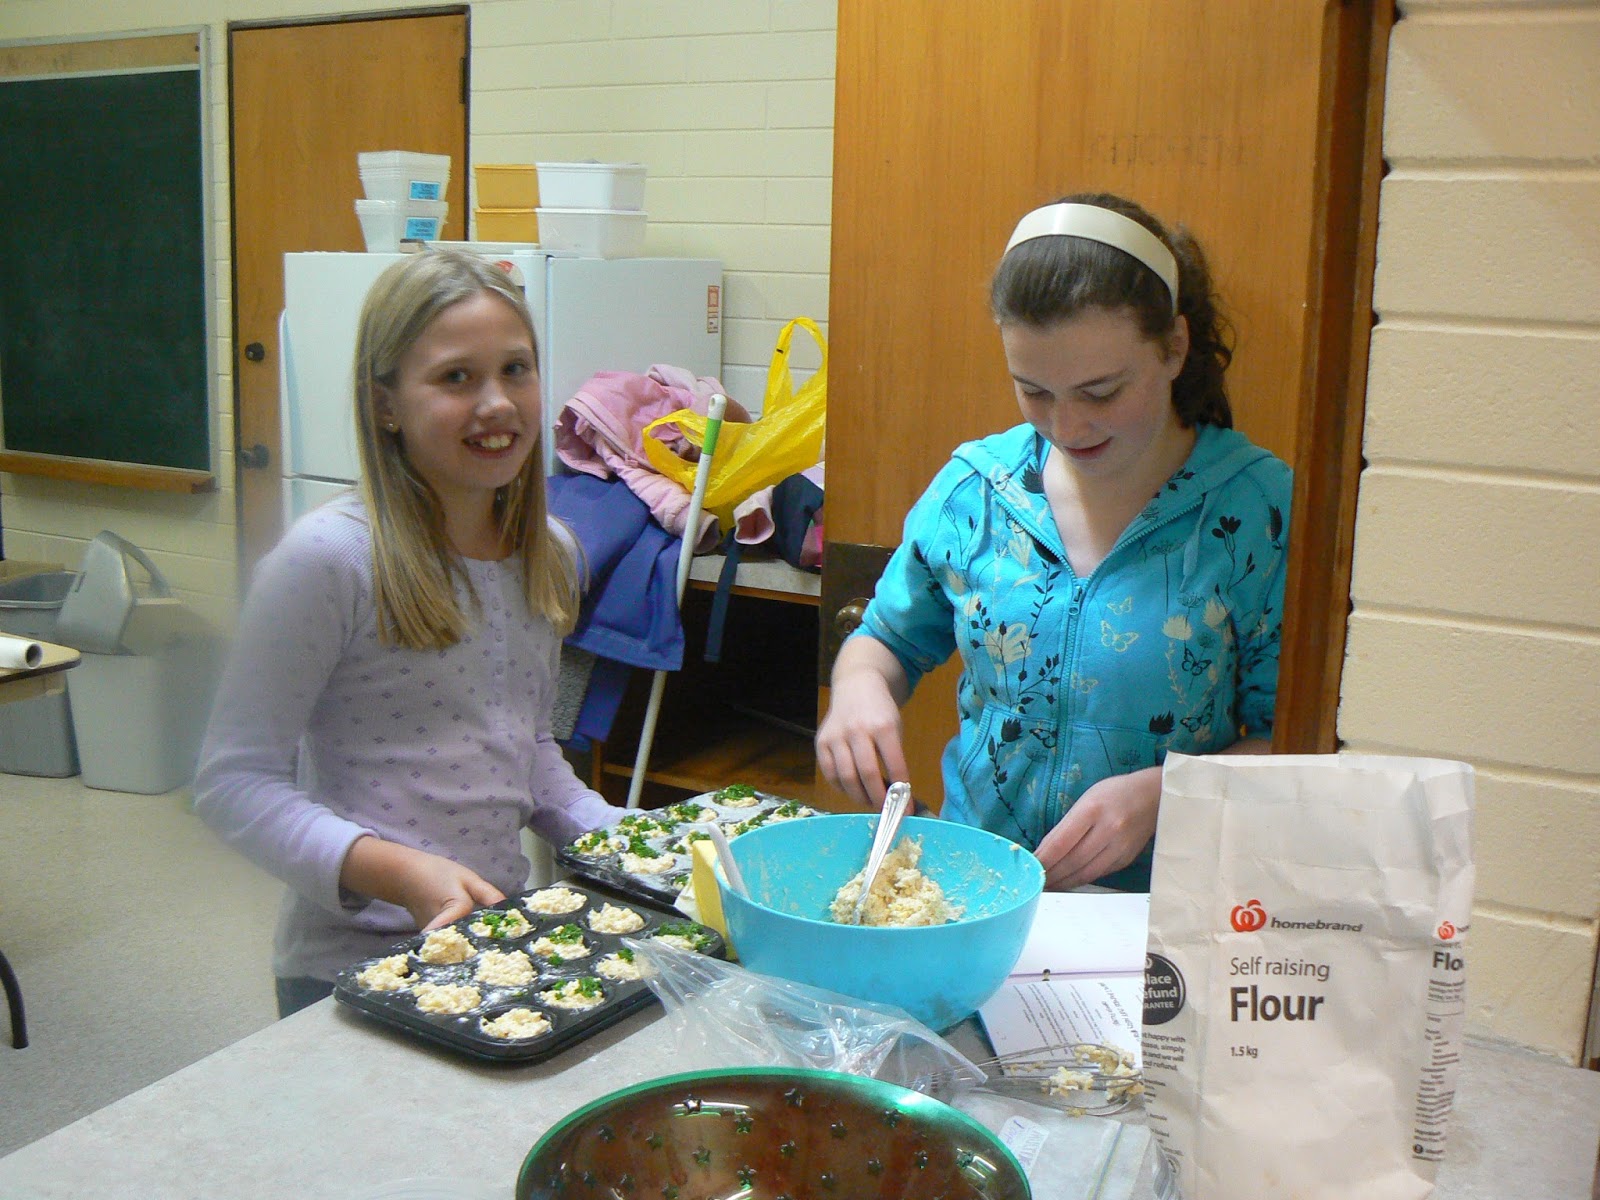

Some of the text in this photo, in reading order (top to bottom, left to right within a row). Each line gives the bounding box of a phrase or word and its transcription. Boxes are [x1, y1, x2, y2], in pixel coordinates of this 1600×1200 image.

[1270, 917, 1363, 932] homebrand
[1432, 951, 1464, 971] Flo
[1229, 956, 1330, 981] Self raising
[1145, 973, 1172, 984] lace
[1230, 985, 1324, 1022] Flour
[1148, 1033, 1169, 1042] happy
[1171, 1035, 1185, 1043] with
[1161, 1044, 1184, 1053] simply
[1231, 1046, 1258, 1058] 1.5 kg
